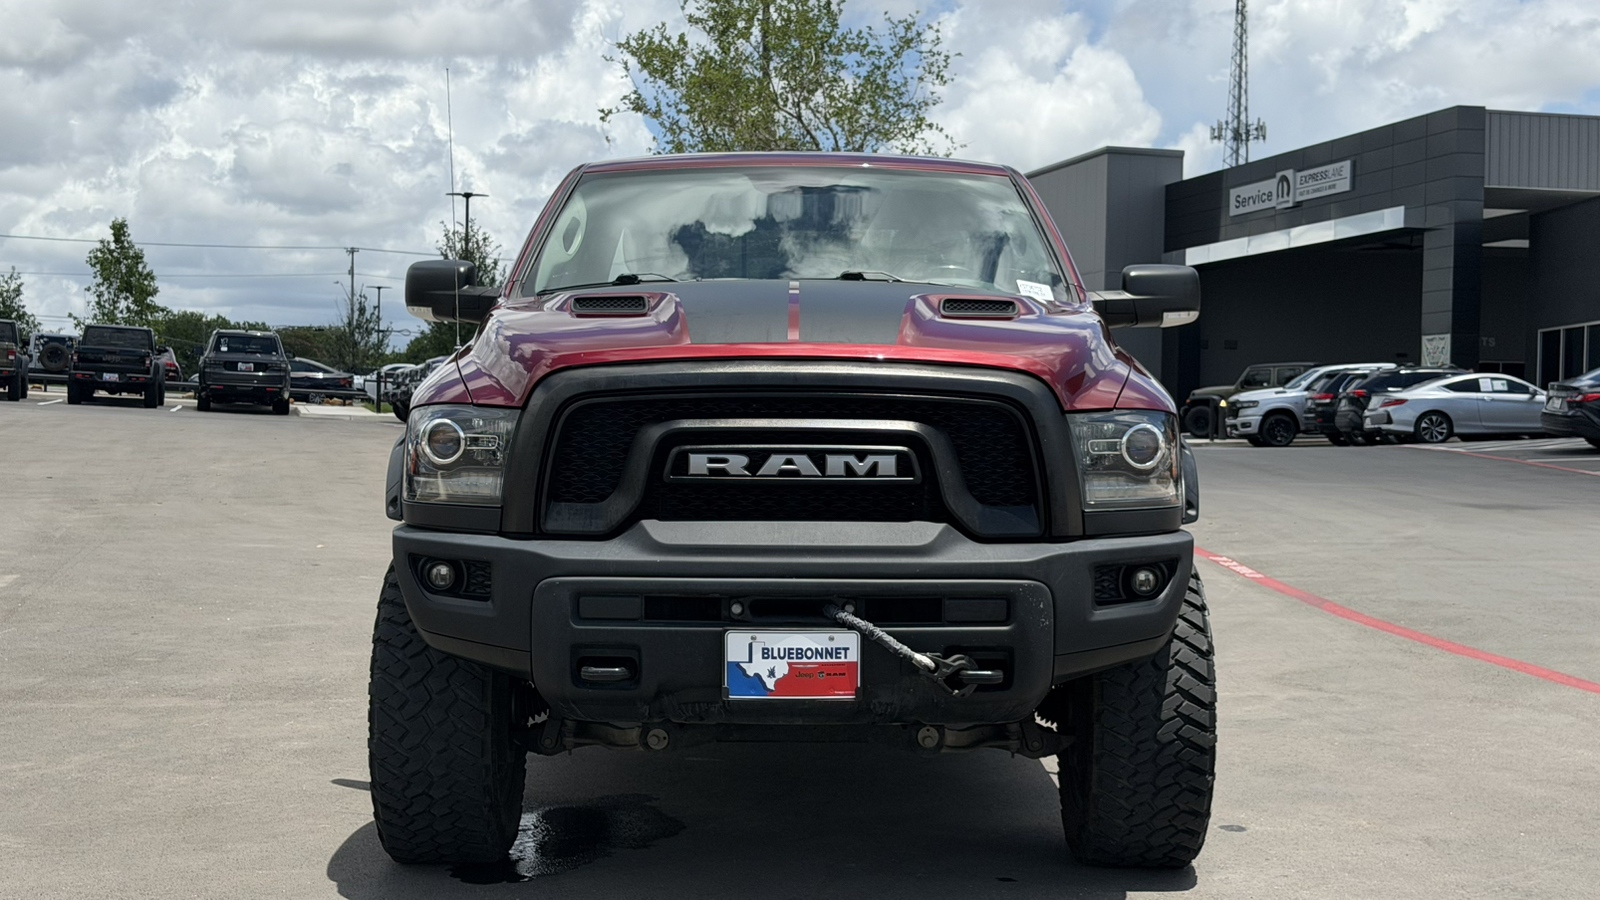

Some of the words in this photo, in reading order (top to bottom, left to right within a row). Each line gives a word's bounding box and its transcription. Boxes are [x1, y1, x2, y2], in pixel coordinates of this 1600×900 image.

[1235, 190, 1273, 209] Service
[688, 453, 898, 476] RAM
[761, 647, 850, 660] BLUEBONNET
[795, 671, 814, 679] Jeep
